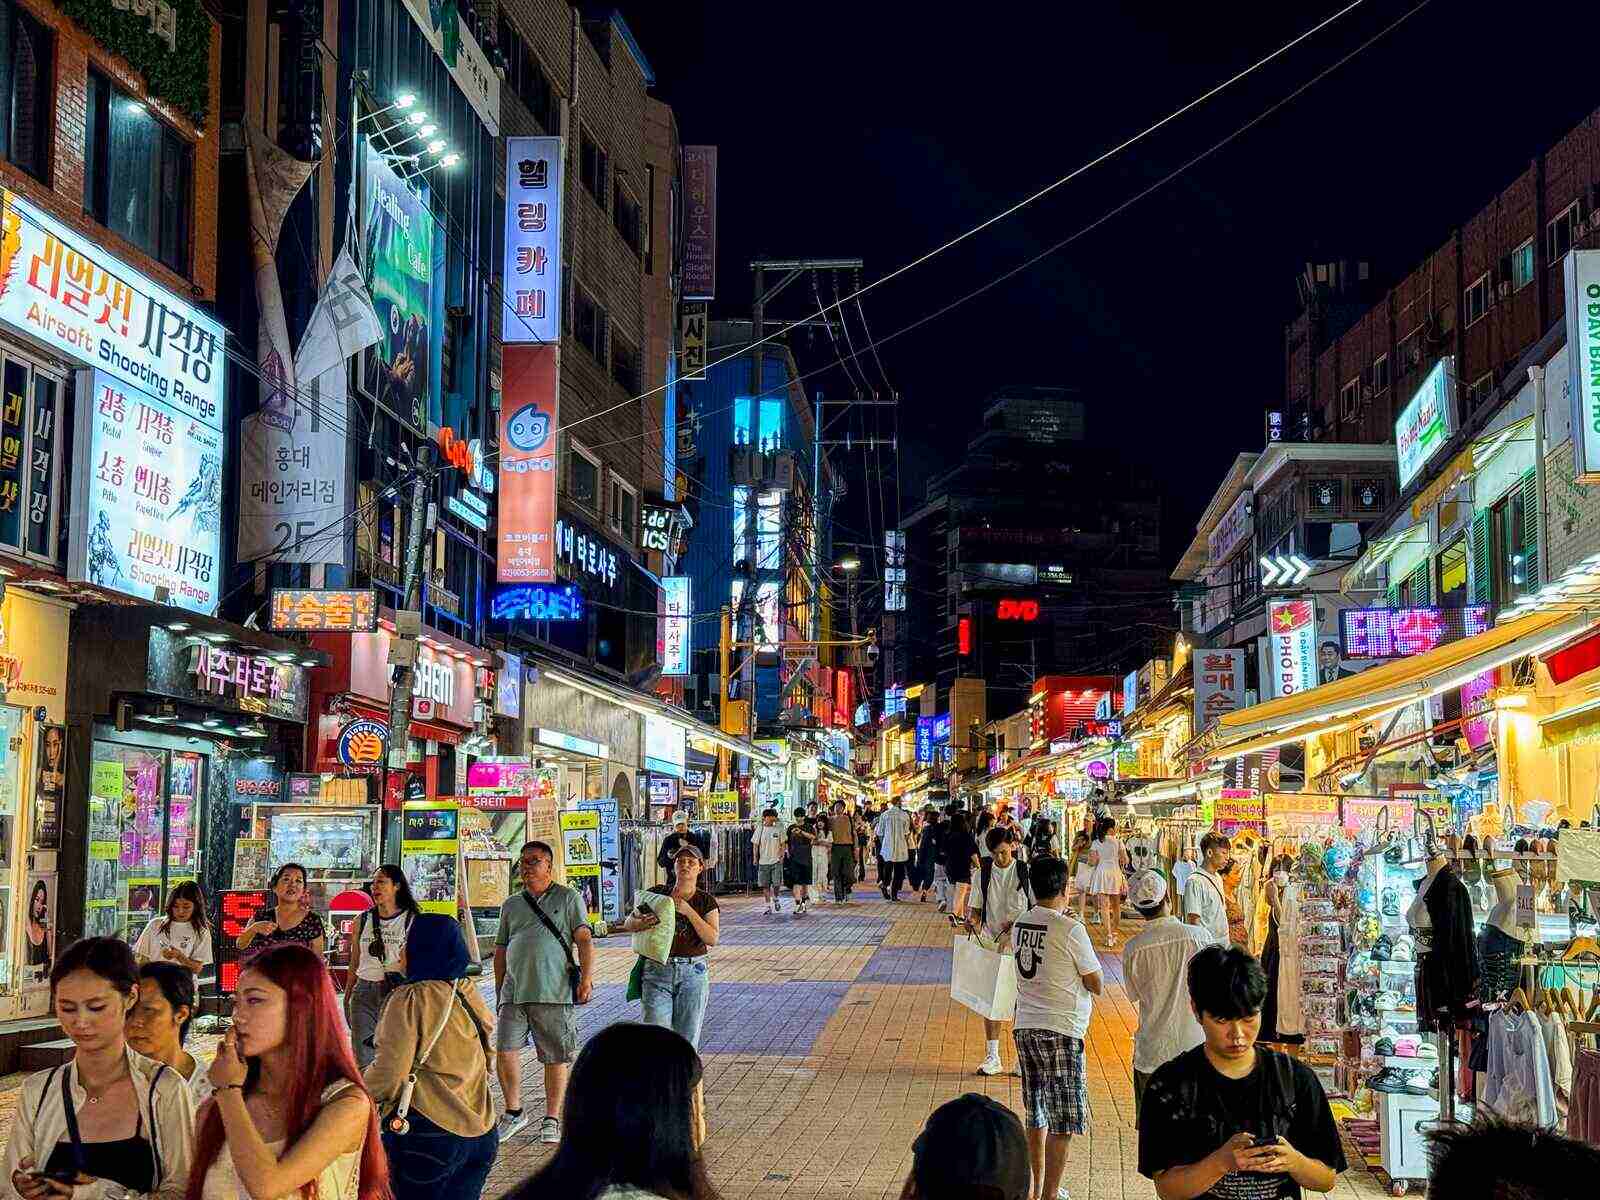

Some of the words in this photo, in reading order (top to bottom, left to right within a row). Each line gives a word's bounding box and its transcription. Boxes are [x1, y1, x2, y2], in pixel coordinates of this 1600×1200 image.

[373, 177, 410, 240] Healing
[517, 158, 548, 319] 힐링카페
[26, 233, 134, 337] 리얼샷!
[138, 296, 217, 384] 사격장
[27, 301, 93, 352] Airsoft
[98, 337, 168, 397] Shooting
[172, 380, 216, 418] Range
[30, 407, 53, 524] 사격장
[275, 446, 310, 471] 홍대
[251, 479, 336, 505] 메인거리점
[273, 521, 316, 554] 2F
[174, 545, 213, 583] 사격장
[129, 565, 176, 595] Shooting
[179, 580, 210, 604] Range
[997, 600, 1038, 620] DVD
[413, 656, 454, 707] SAEM
[473, 797, 506, 808] SAEM
[1518, 896, 1534, 911] SALE
[1014, 922, 1048, 950] TRUE
